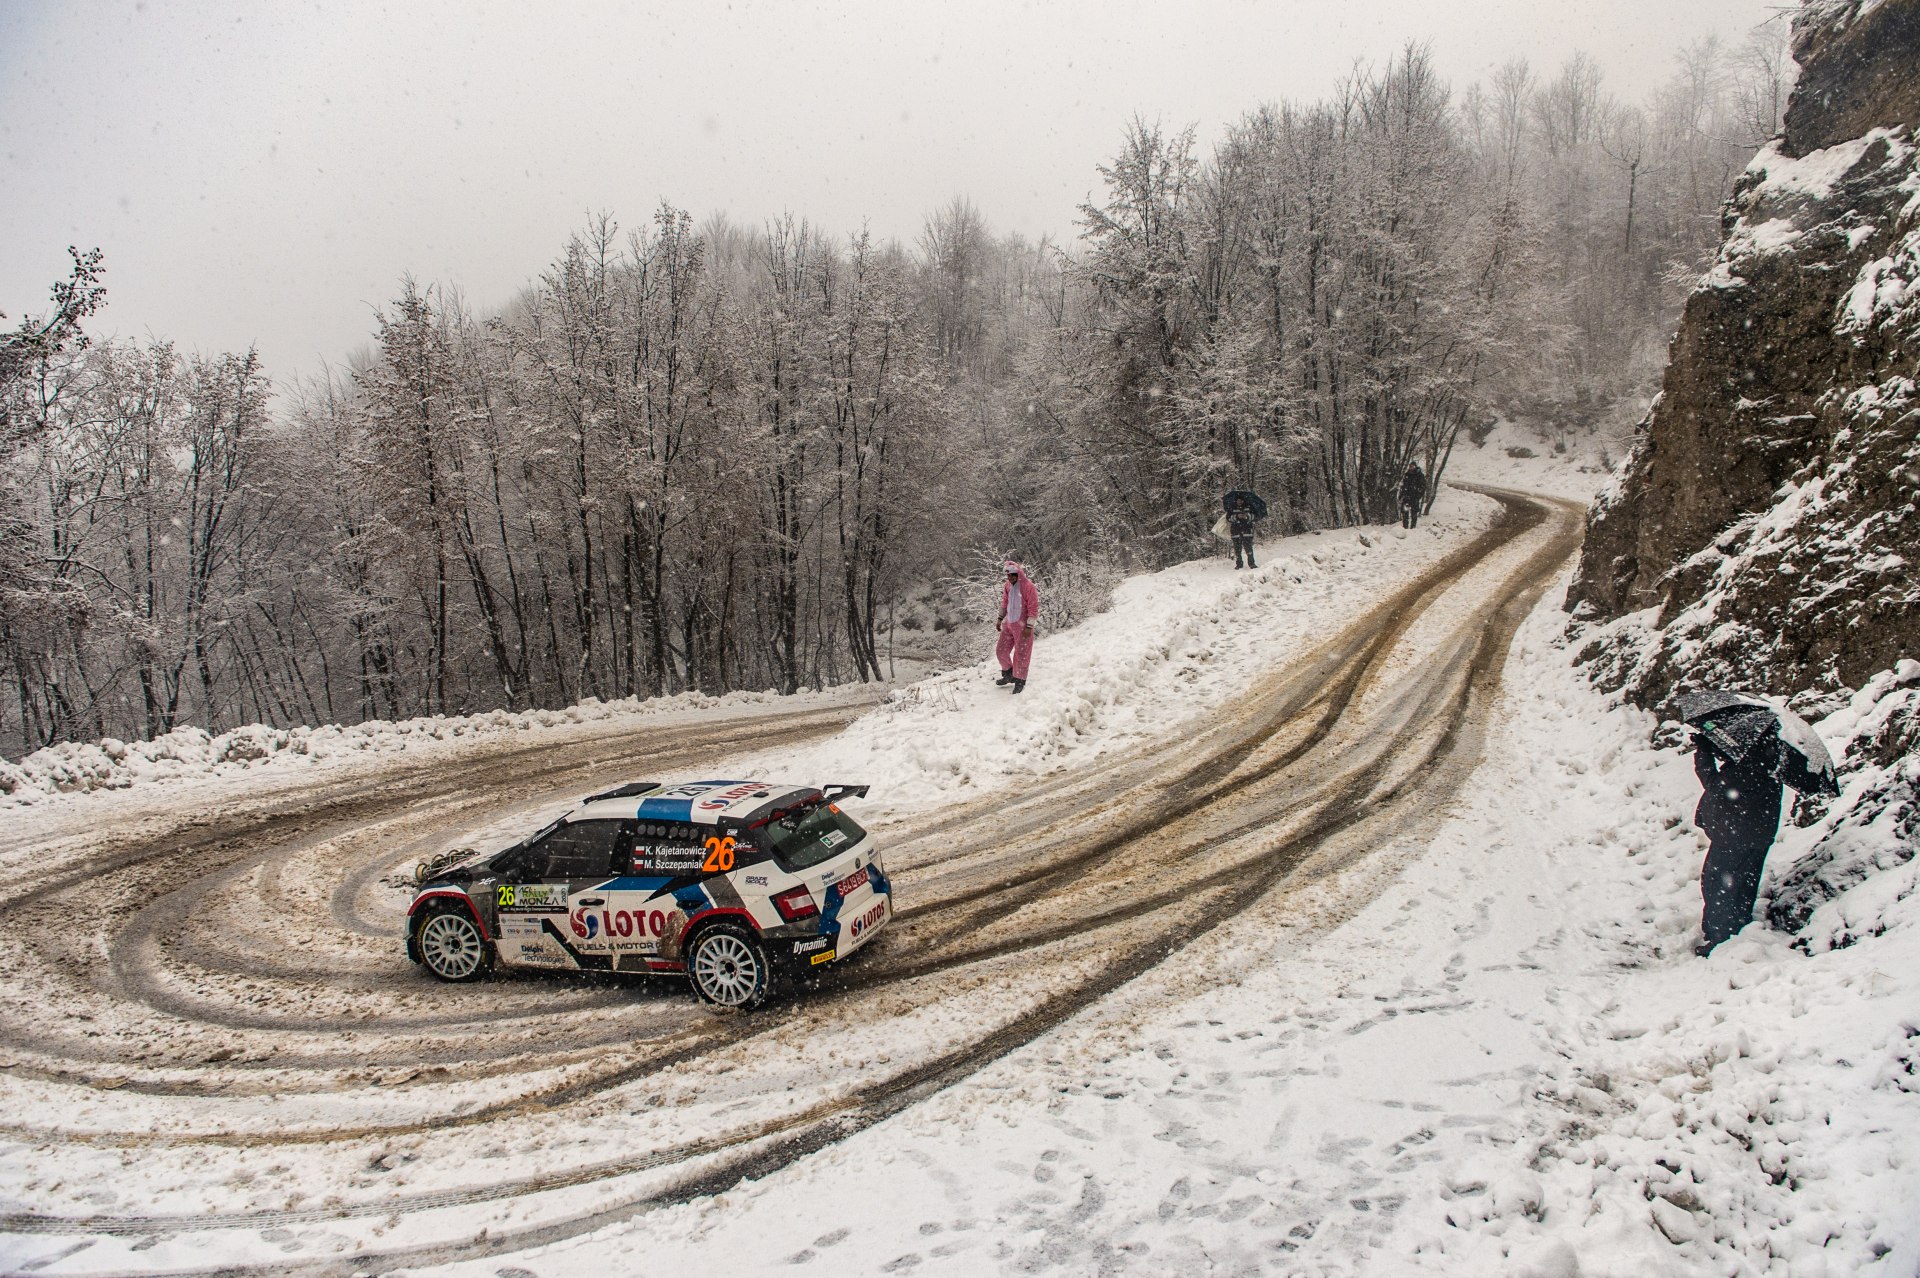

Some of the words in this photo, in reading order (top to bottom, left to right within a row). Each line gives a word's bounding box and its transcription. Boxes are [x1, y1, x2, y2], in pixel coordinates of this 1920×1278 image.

[645, 846, 653, 855] K.
[655, 845, 707, 857] Kajetanowicz
[702, 836, 735, 872] 26
[644, 859, 654, 869] M.
[655, 859, 704, 870] Szczepaniak
[498, 886, 515, 905] 26
[522, 890, 548, 898] RALLY
[519, 897, 560, 905] MONZA
[863, 900, 885, 930] LOTOS
[616, 942, 655, 950] MOTOR
[793, 936, 828, 955] Dynamic
